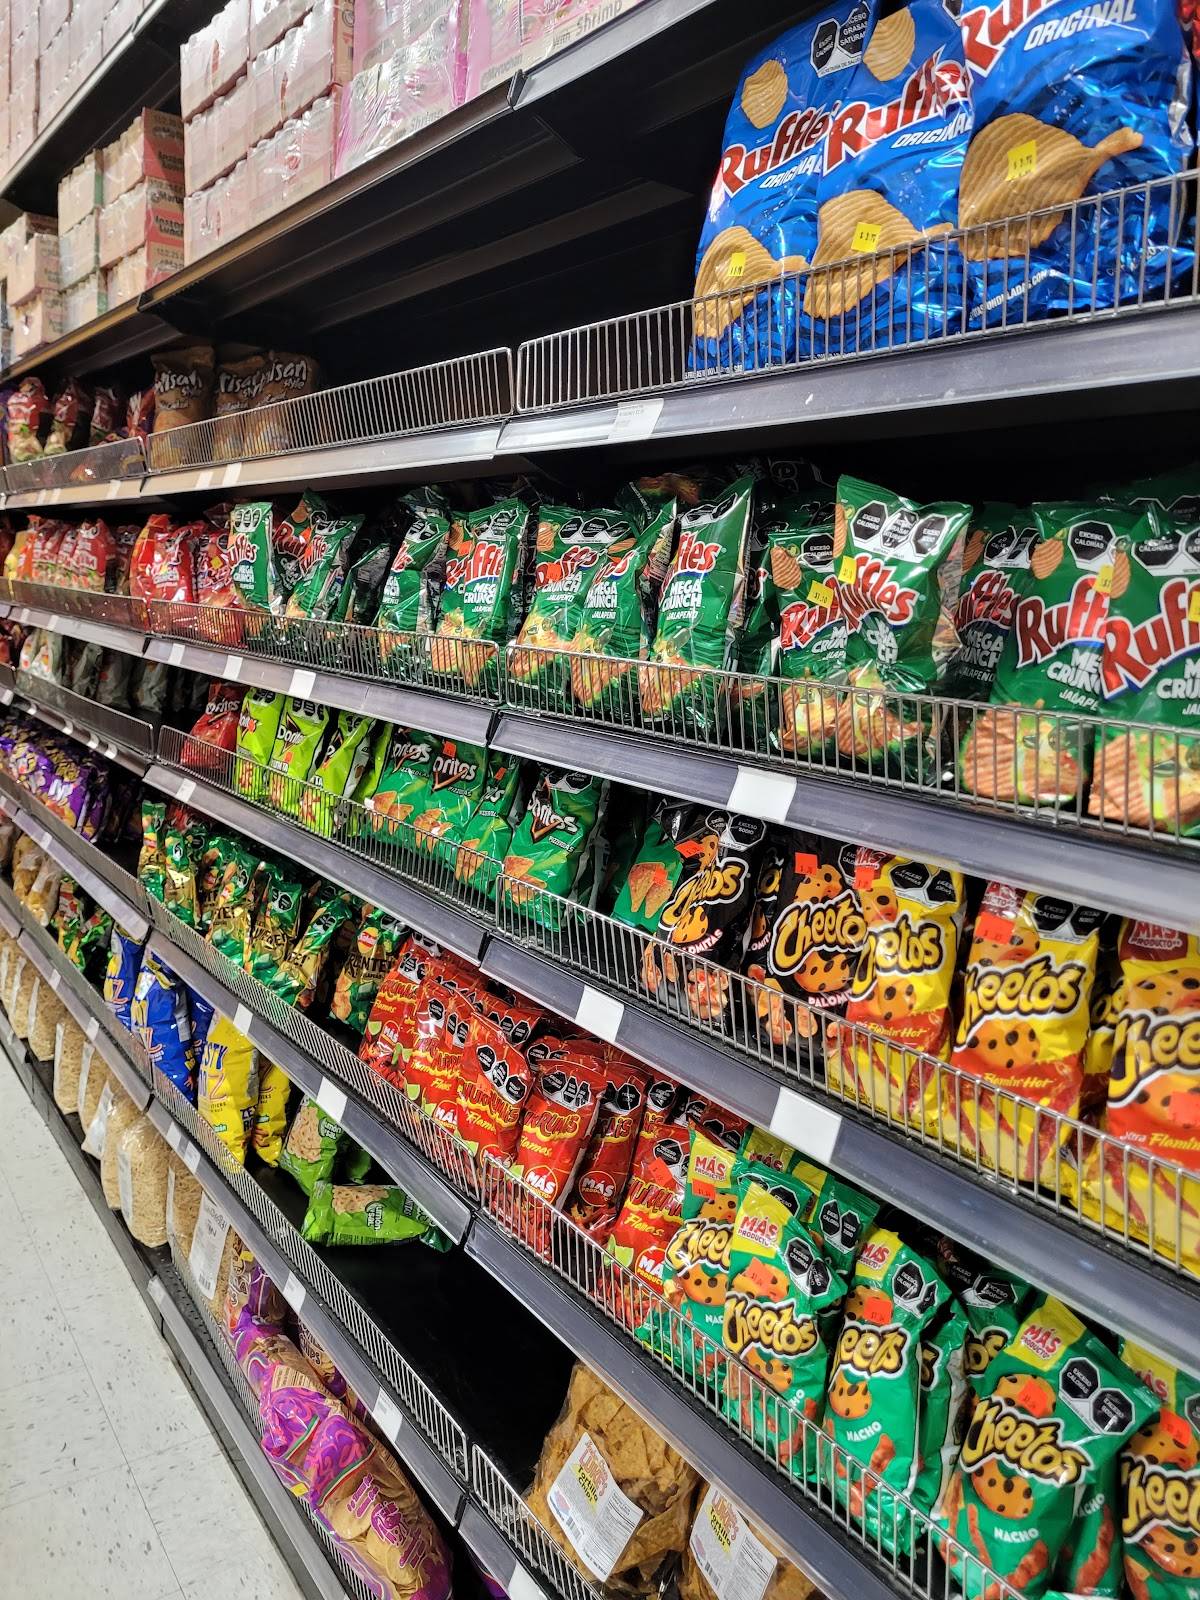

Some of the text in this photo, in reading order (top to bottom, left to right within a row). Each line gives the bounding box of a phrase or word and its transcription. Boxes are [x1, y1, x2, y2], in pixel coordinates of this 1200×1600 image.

[1024, 0, 1137, 50] ORIGINAL
[669, 579, 702, 594] MEGA
[770, 892, 867, 976] Cheeto
[1023, 1074, 1052, 1089] Hot
[695, 1155, 727, 1177] MÁS
[526, 1170, 556, 1195] MÁS
[582, 1177, 615, 1198] MÁS
[740, 1216, 779, 1238] MÁS
[722, 1292, 819, 1358] Cheetos
[1022, 1324, 1061, 1354] MÁS
[846, 1420, 882, 1442] NACHO
[961, 1399, 1091, 1487] Cheetos
[577, 1463, 599, 1502] Tortilla
[710, 1506, 731, 1547] Tortilla
[993, 1526, 1039, 1544] NACHO
